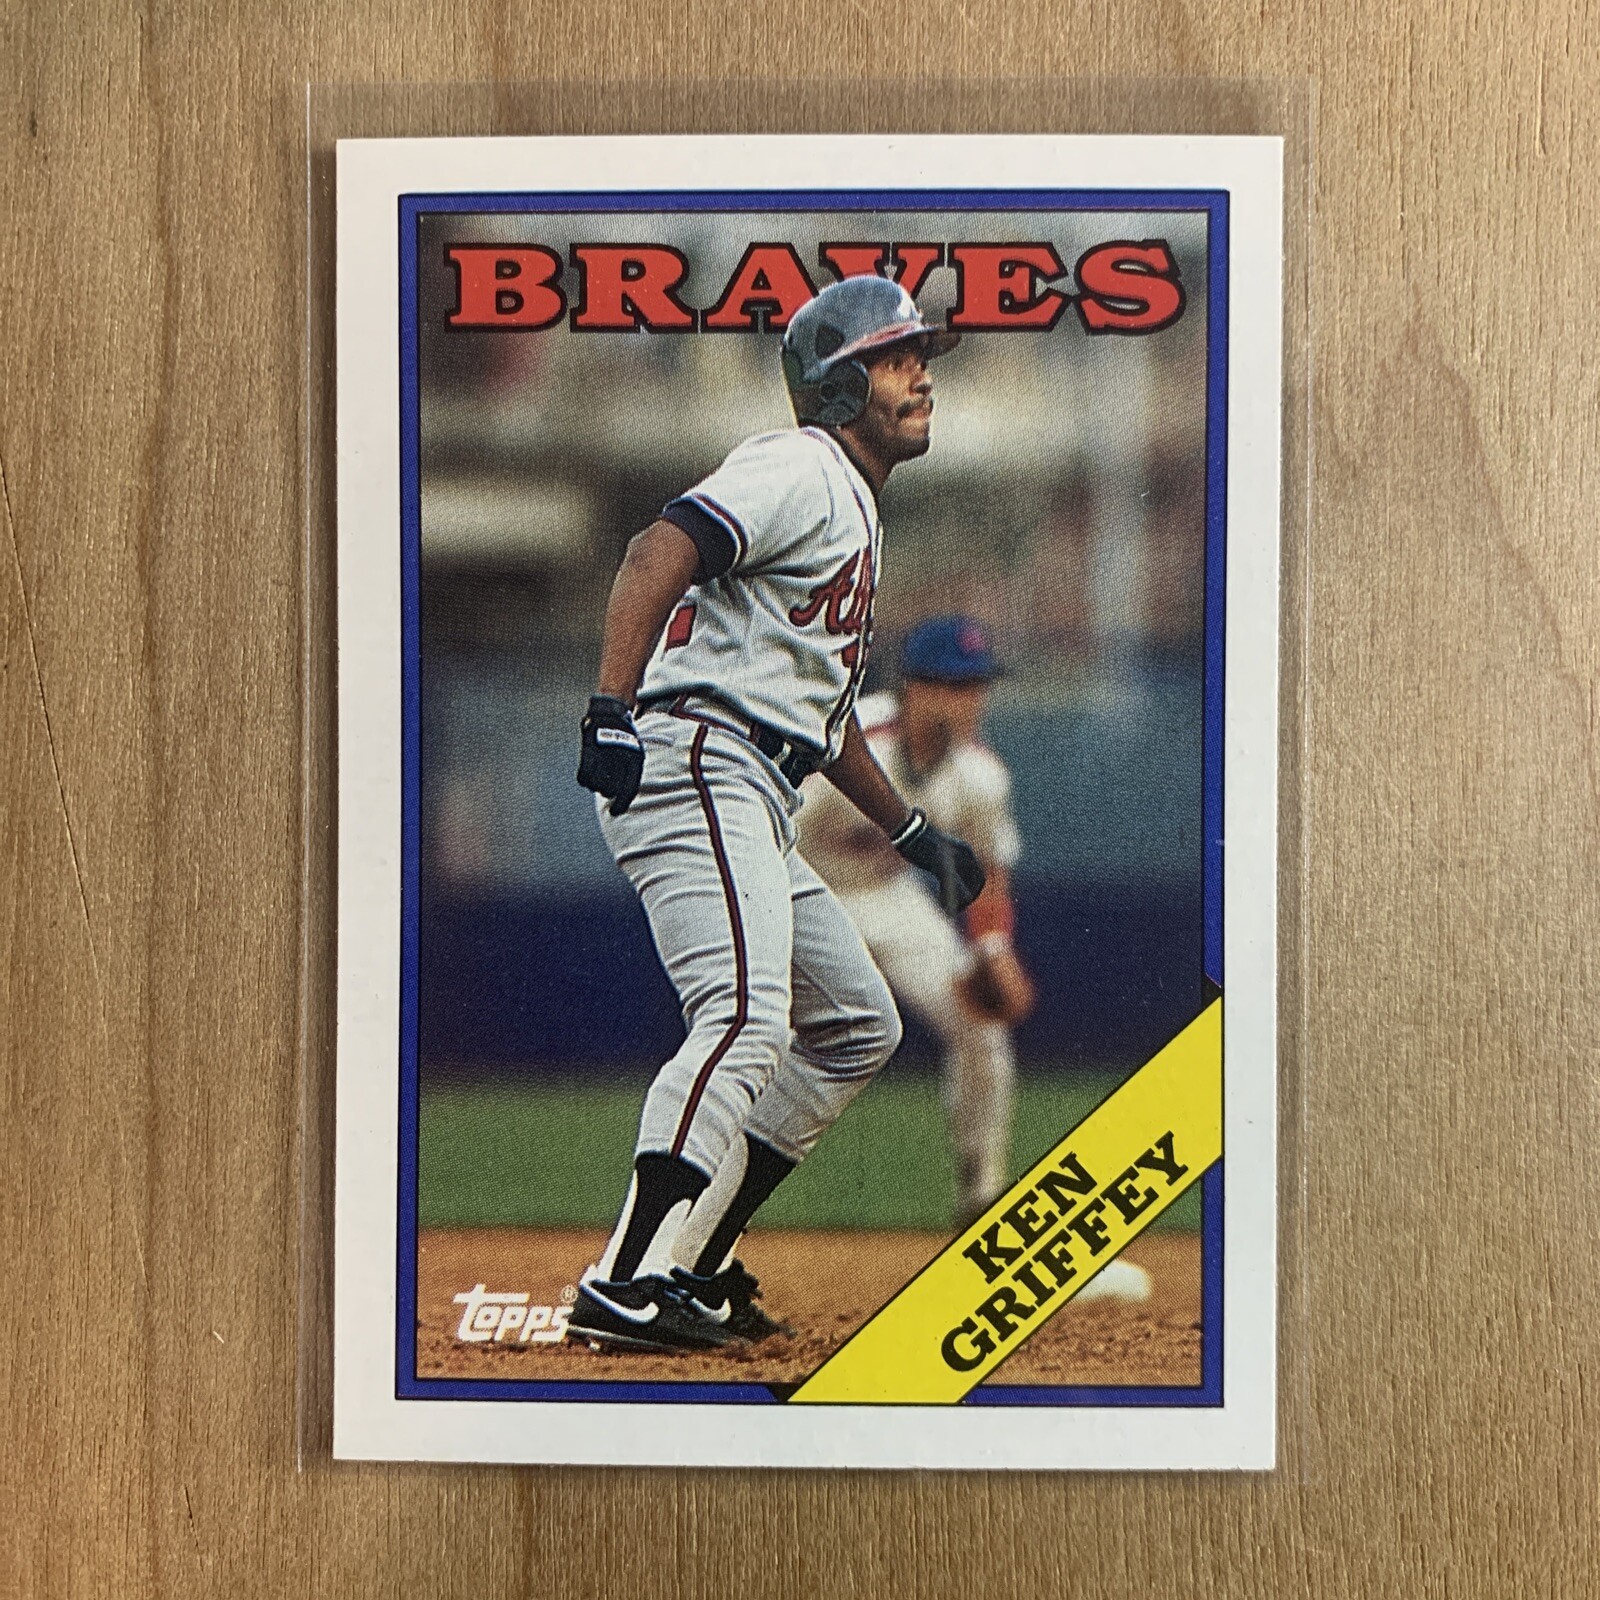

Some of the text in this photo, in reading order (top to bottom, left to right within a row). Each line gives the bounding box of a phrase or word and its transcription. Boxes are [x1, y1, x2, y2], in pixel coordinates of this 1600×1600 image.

[443, 240, 1185, 335] BRAVES
[941, 1130, 1189, 1372] GRIFFEY
[962, 1151, 1098, 1284] KEN
